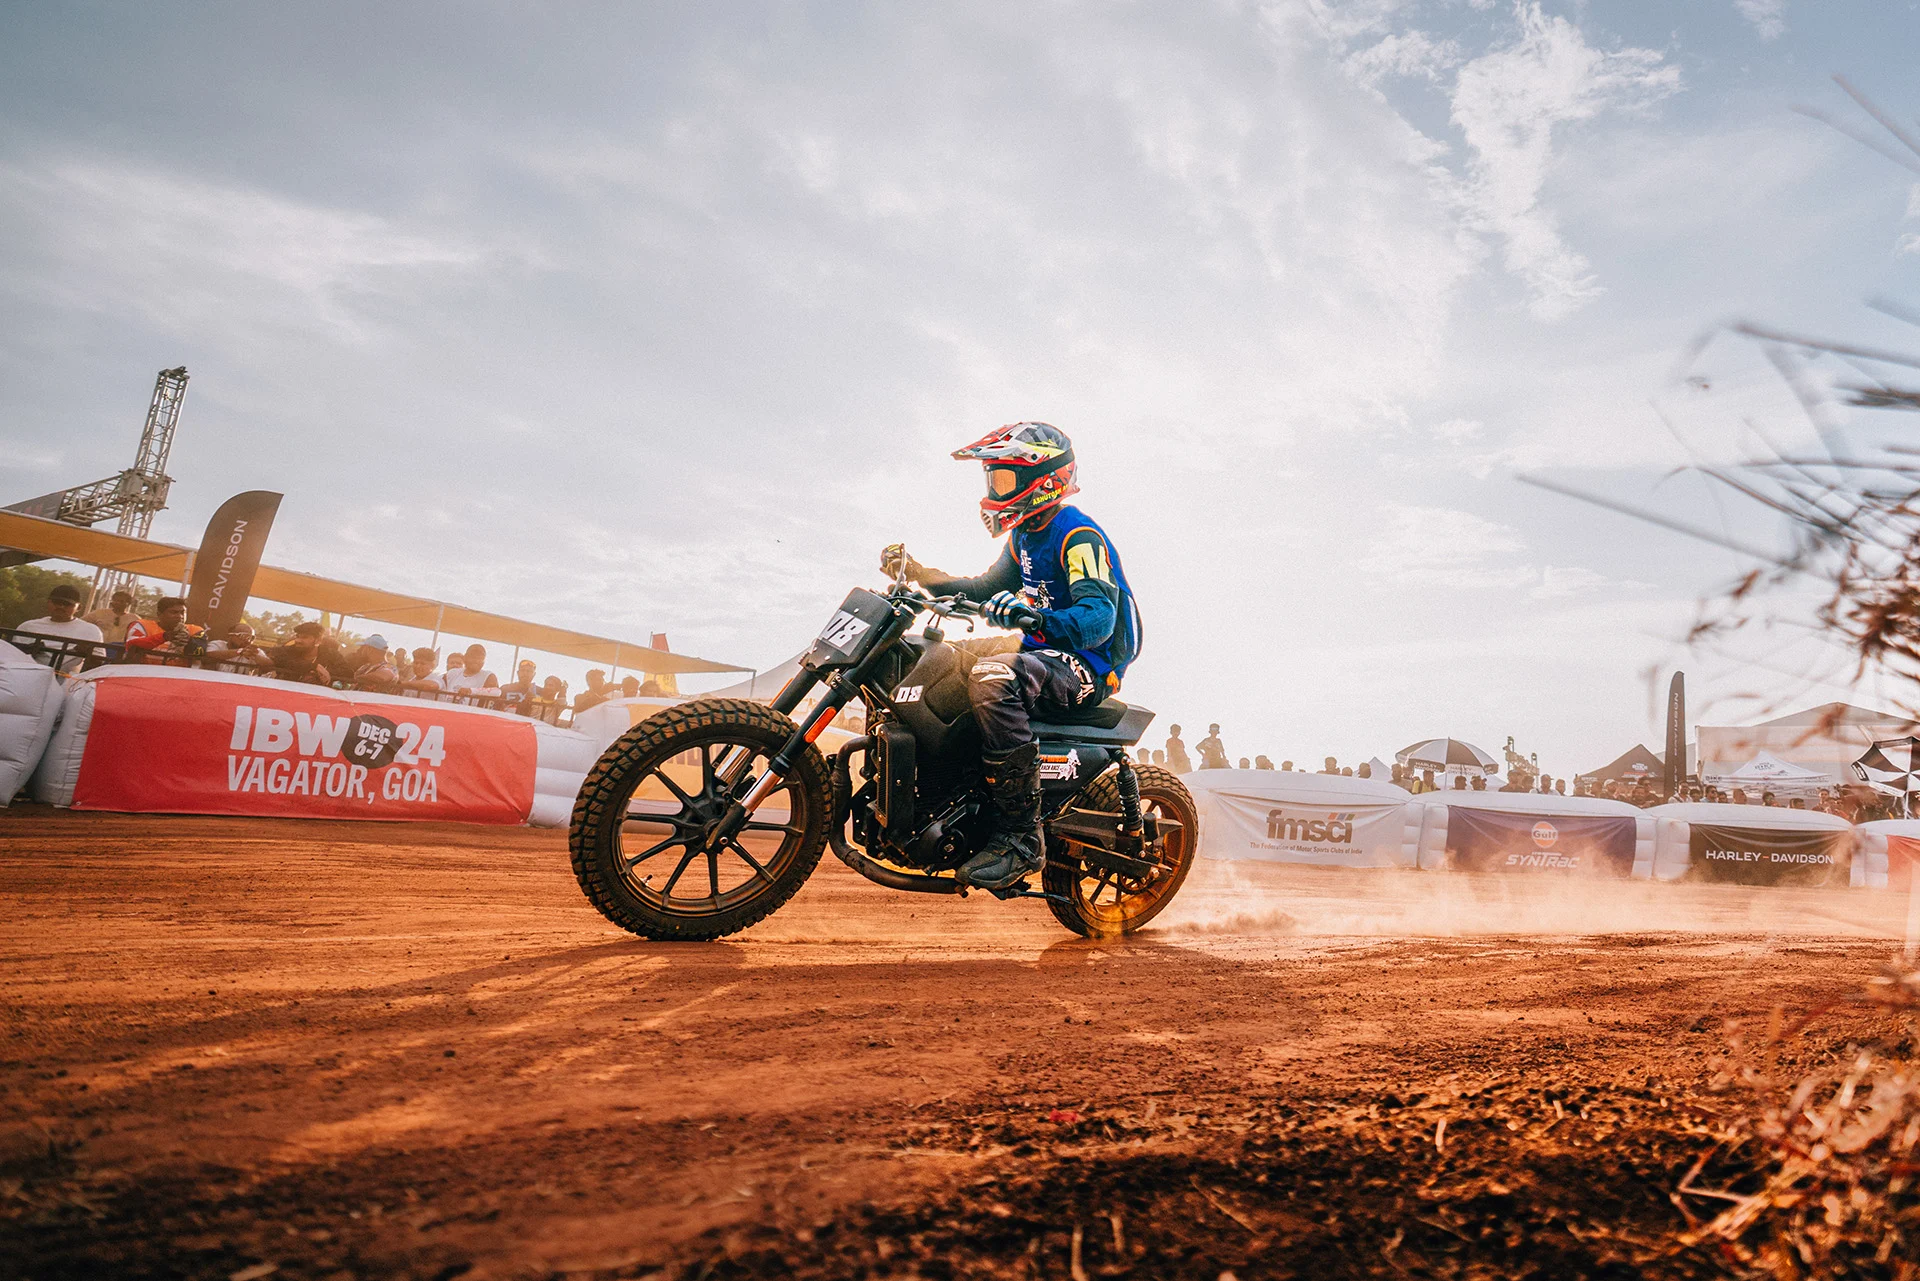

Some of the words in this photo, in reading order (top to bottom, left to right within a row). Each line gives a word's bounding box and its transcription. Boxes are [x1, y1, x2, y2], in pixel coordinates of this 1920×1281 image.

[208, 519, 248, 609] DAVIDSON
[819, 610, 871, 648] 08
[894, 685, 924, 703] 08
[230, 705, 351, 758] IBW
[393, 722, 446, 767] 24
[357, 721, 391, 745] DEC
[354, 739, 384, 761] 6-7
[228, 755, 375, 805] VAGATOR,
[383, 767, 437, 802] GOA
[1266, 809, 1354, 844] fmsci
[1533, 829, 1557, 839] Gulf
[1250, 841, 1259, 849] The
